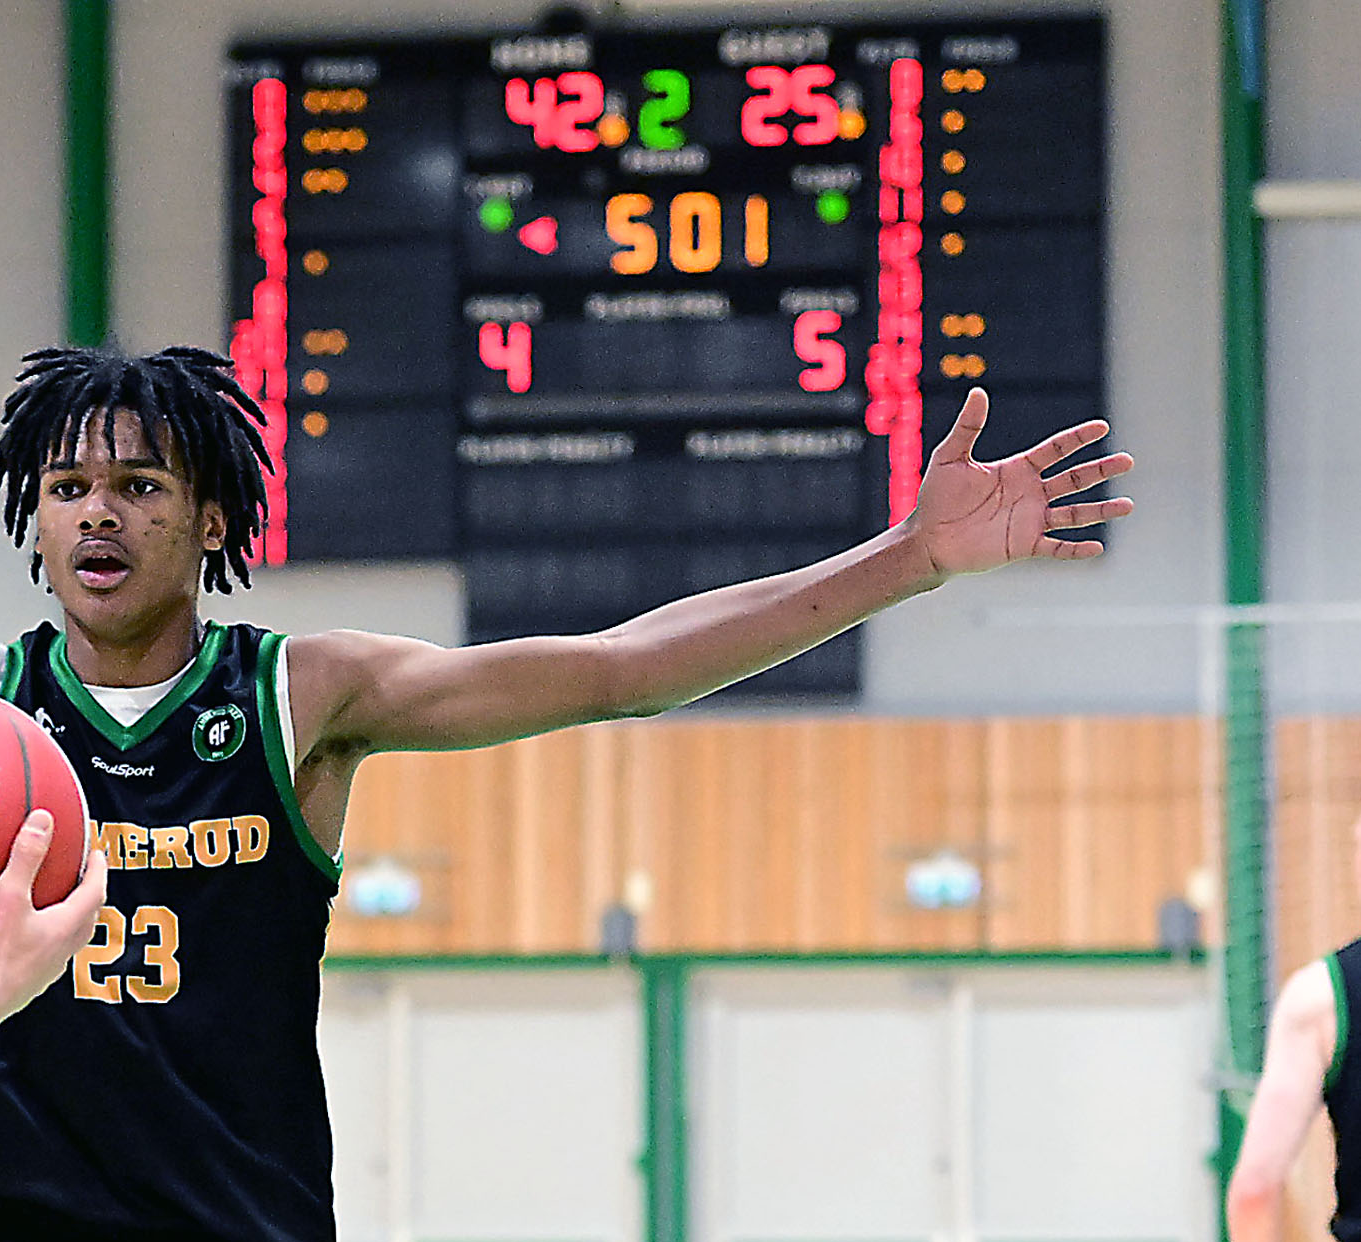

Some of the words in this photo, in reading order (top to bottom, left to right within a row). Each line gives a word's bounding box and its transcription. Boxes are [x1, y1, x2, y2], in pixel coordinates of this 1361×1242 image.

[505, 71, 604, 152] 42
[639, 69, 689, 150] 2
[741, 64, 840, 147] 25
[479, 322, 532, 393] 4
[793, 309, 846, 391] 5
[73, 905, 180, 1003] 23
